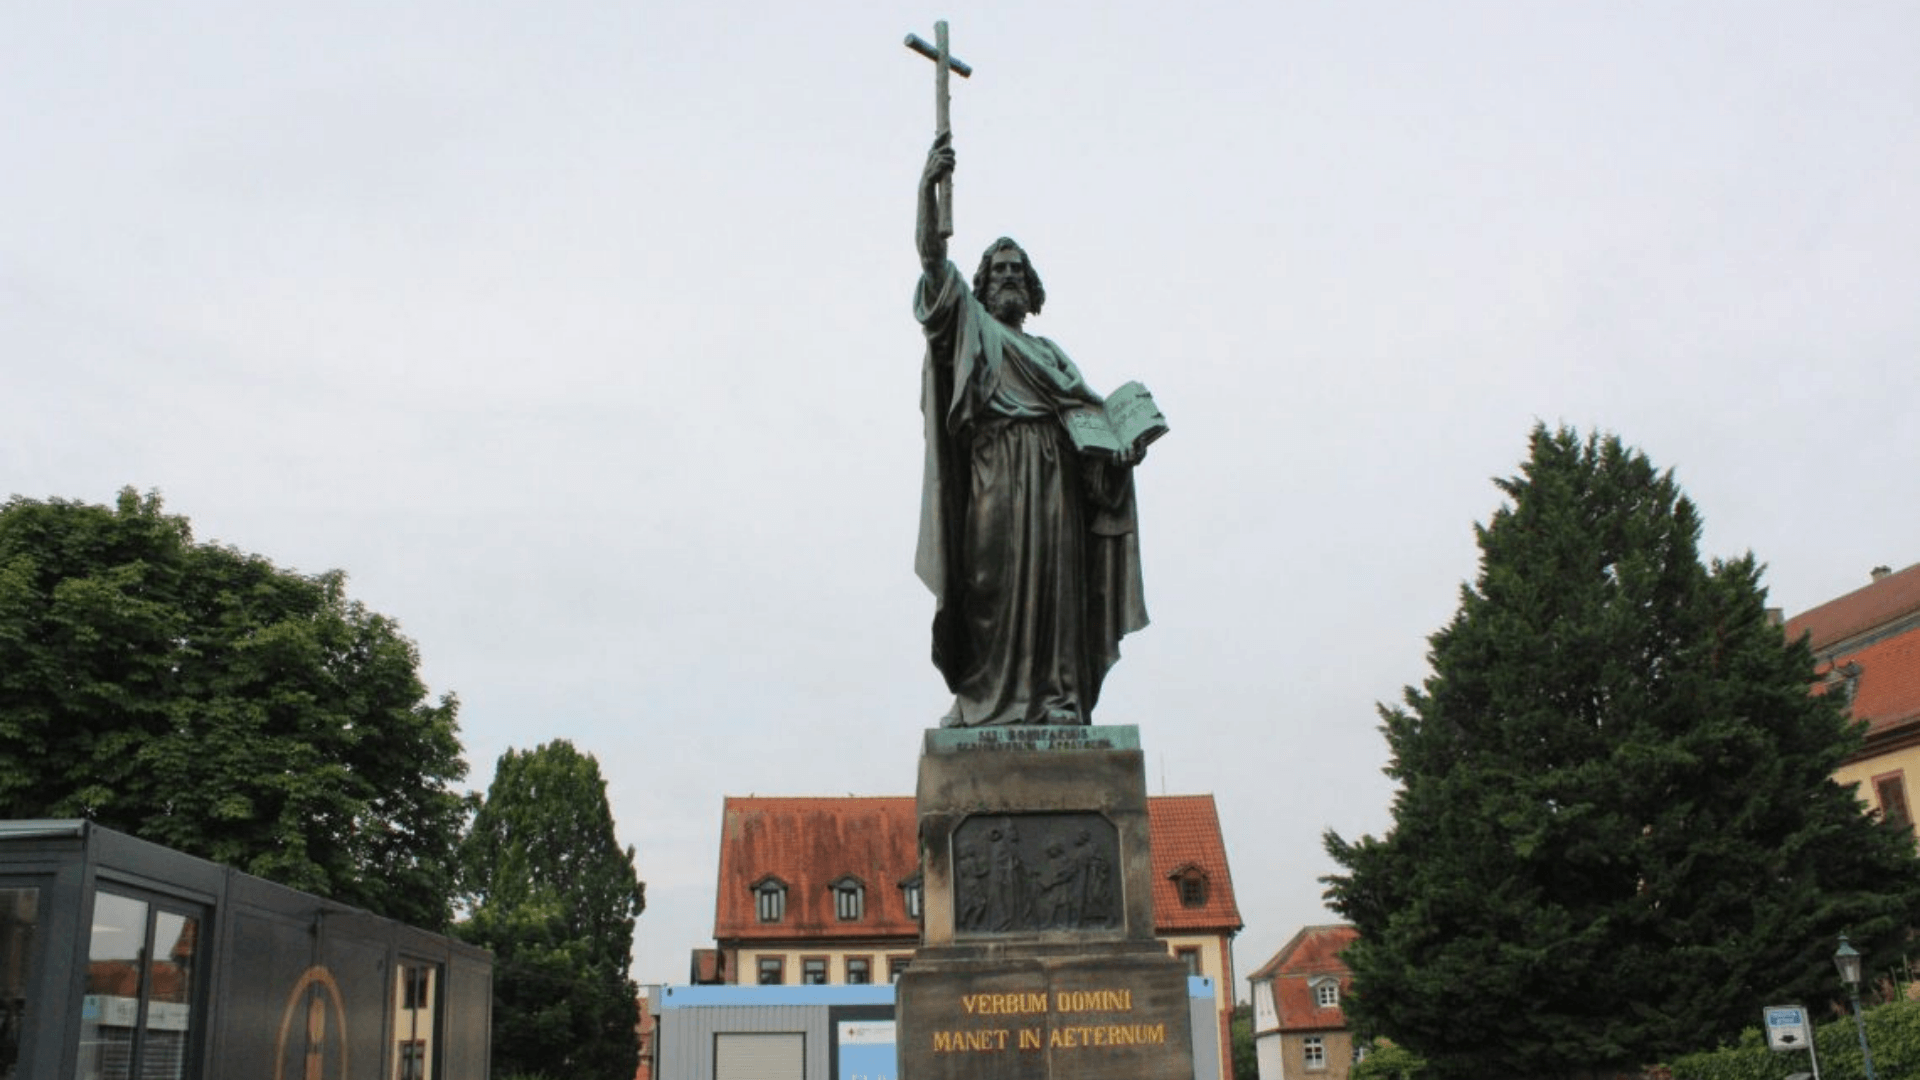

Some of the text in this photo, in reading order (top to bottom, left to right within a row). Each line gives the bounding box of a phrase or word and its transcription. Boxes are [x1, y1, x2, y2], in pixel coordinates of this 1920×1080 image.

[962, 989, 1132, 1014] VERBUM DOMINI
[933, 1023, 1166, 1051] MANET IN AETERNUM
